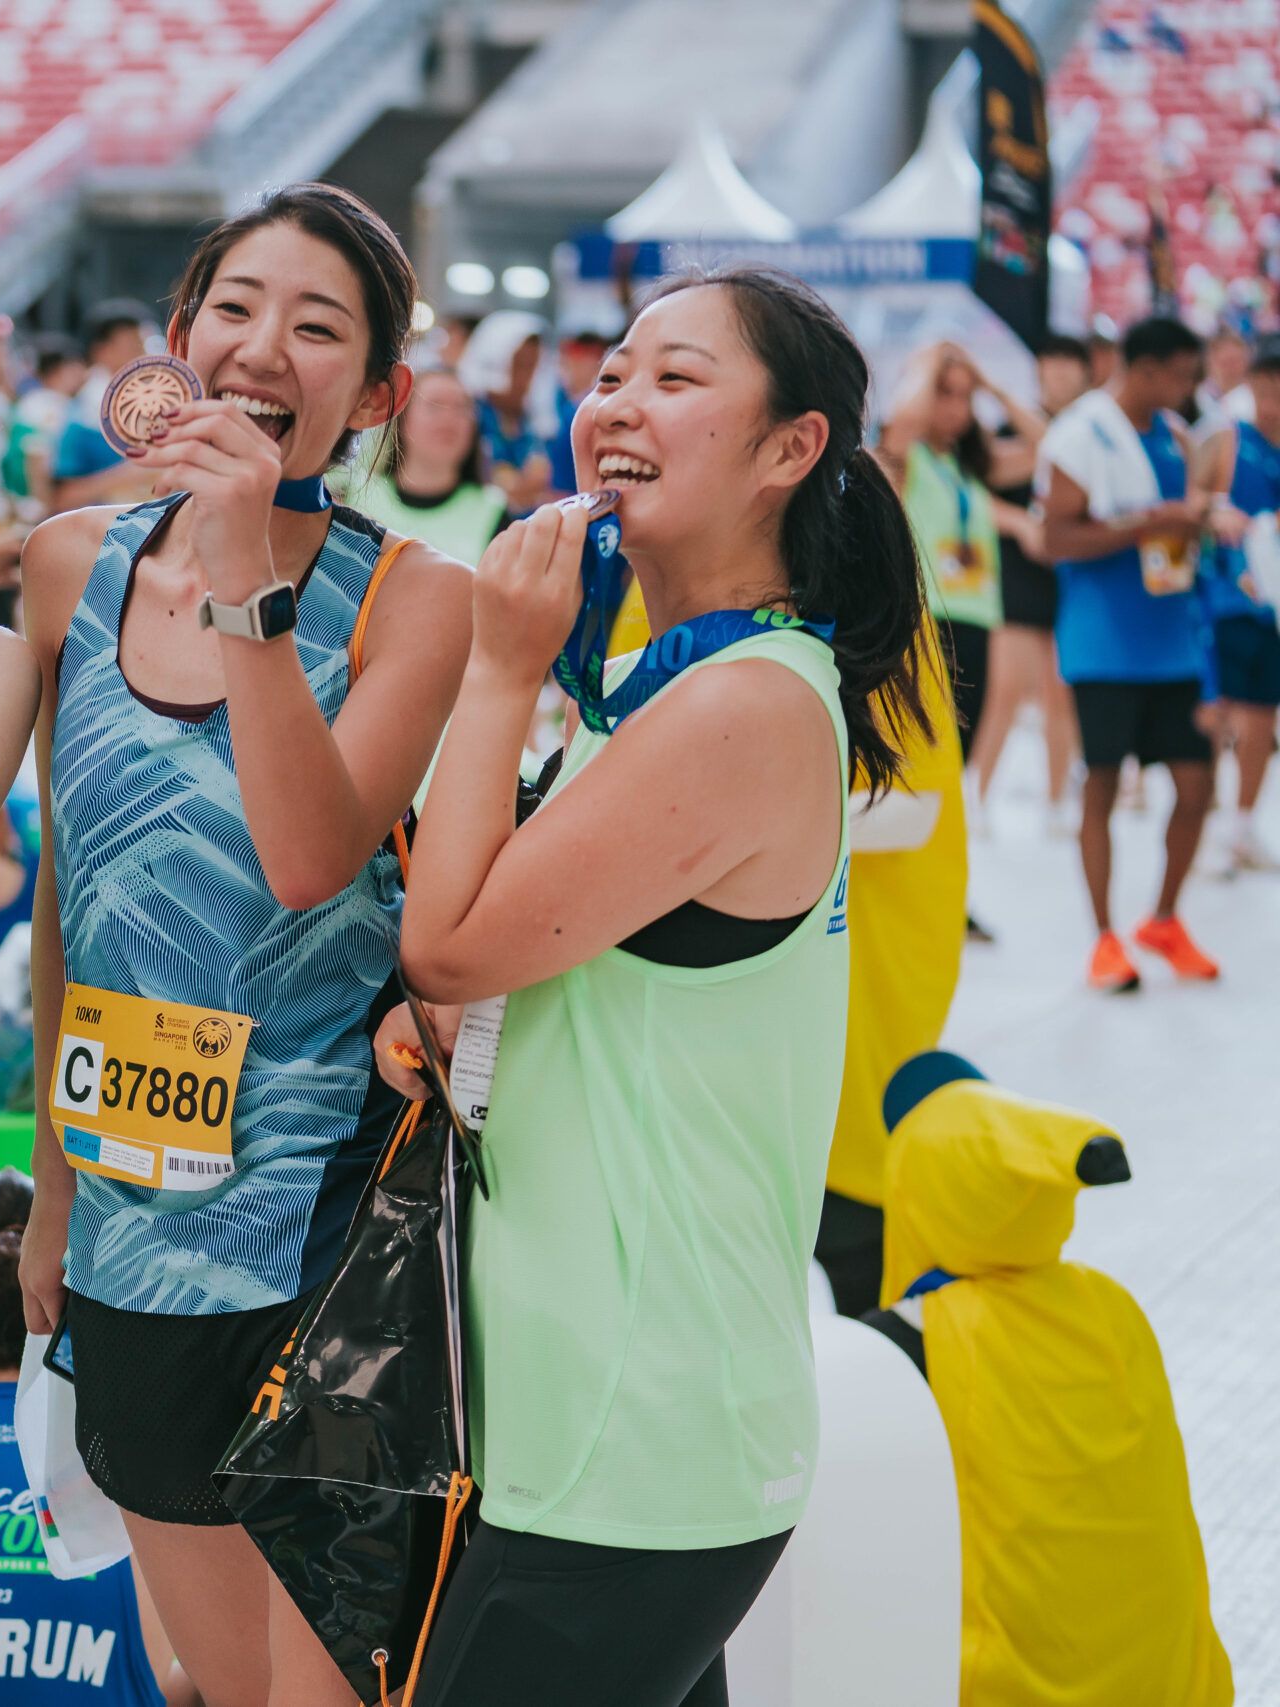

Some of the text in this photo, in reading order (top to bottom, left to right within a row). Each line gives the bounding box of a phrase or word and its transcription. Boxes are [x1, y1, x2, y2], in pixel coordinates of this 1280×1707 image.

[75, 1005, 102, 1025] 10KM
[154, 1030, 188, 1042] SINGAPORE
[464, 1023, 494, 1035] MEDICAL
[64, 1046, 229, 1128] C 37880
[506, 1484, 543, 1502] DRYCELL
[763, 1472, 804, 1507] PUMA
